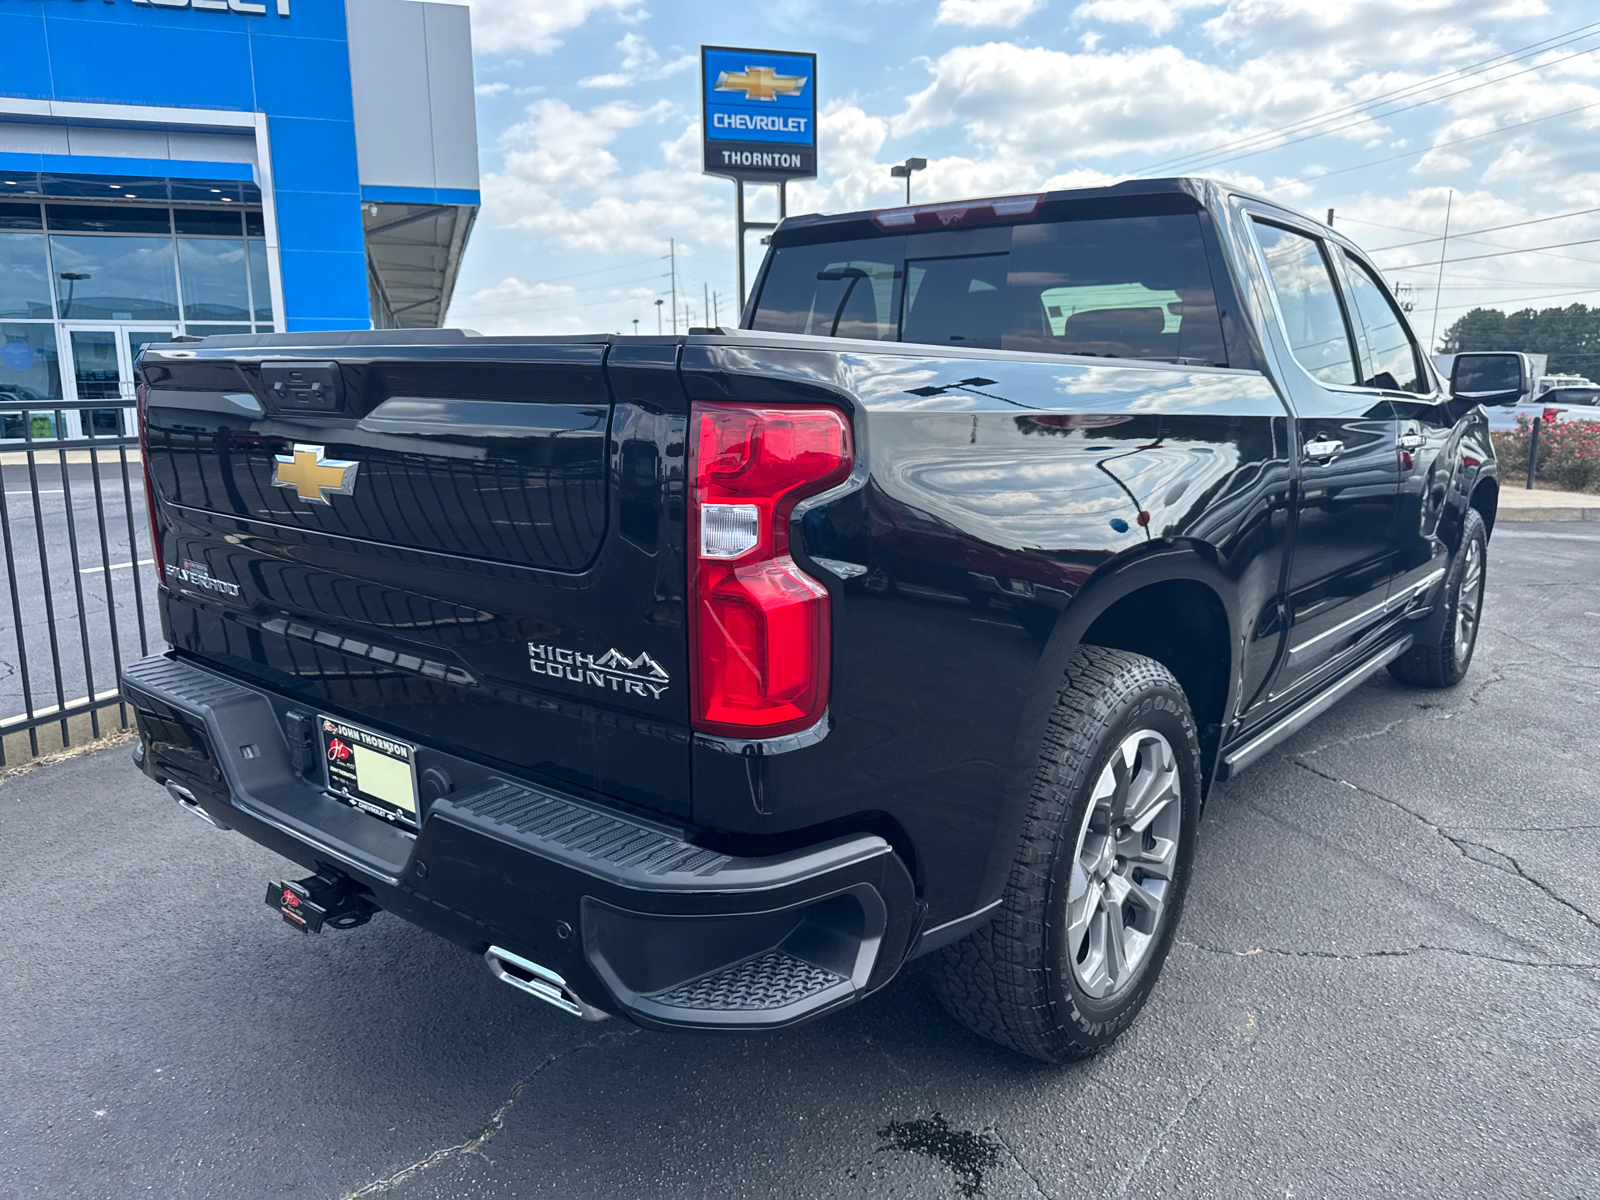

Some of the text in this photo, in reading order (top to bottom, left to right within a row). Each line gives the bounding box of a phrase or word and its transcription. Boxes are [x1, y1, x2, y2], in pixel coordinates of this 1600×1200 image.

[713, 113, 808, 132] CHEVROLET
[722, 150, 801, 168] THORNTON
[165, 563, 240, 597] SILVERADO
[528, 642, 594, 668] HIGH
[530, 658, 669, 700] COUNTRY
[338, 724, 408, 758] JOHN THORNTON
[358, 801, 386, 818] CHEVROLET
